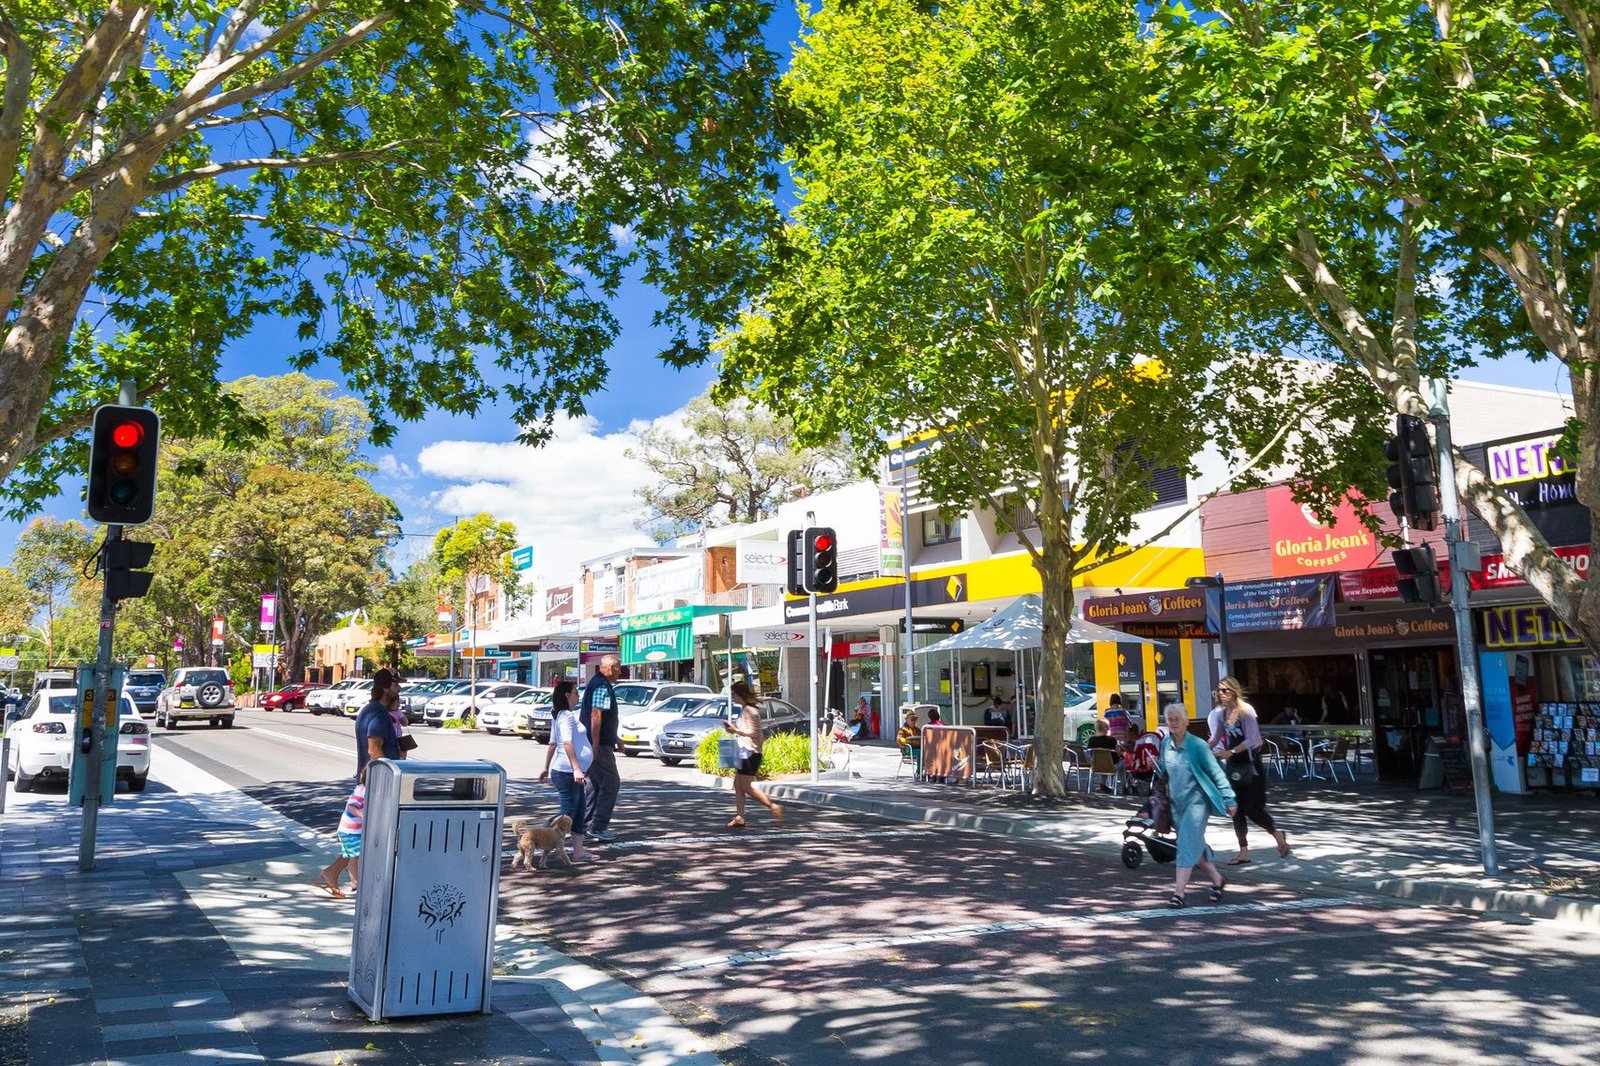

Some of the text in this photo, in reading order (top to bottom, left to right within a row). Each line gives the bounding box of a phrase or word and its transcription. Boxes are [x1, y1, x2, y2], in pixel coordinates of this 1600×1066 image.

[1275, 530, 1368, 556] Gloria Jean's
[744, 553, 774, 565] select
[1296, 551, 1348, 567] COFFEES
[1344, 583, 1398, 596] www.fixyouriphon
[1089, 596, 1202, 618] Gloria Jean's Coffees
[1246, 599, 1268, 609] Jean's
[1280, 596, 1310, 606] Coffees
[764, 630, 789, 641] select
[1334, 619, 1449, 638] Gloria Jean's Coffees
[635, 629, 679, 654] BUTCHERY
